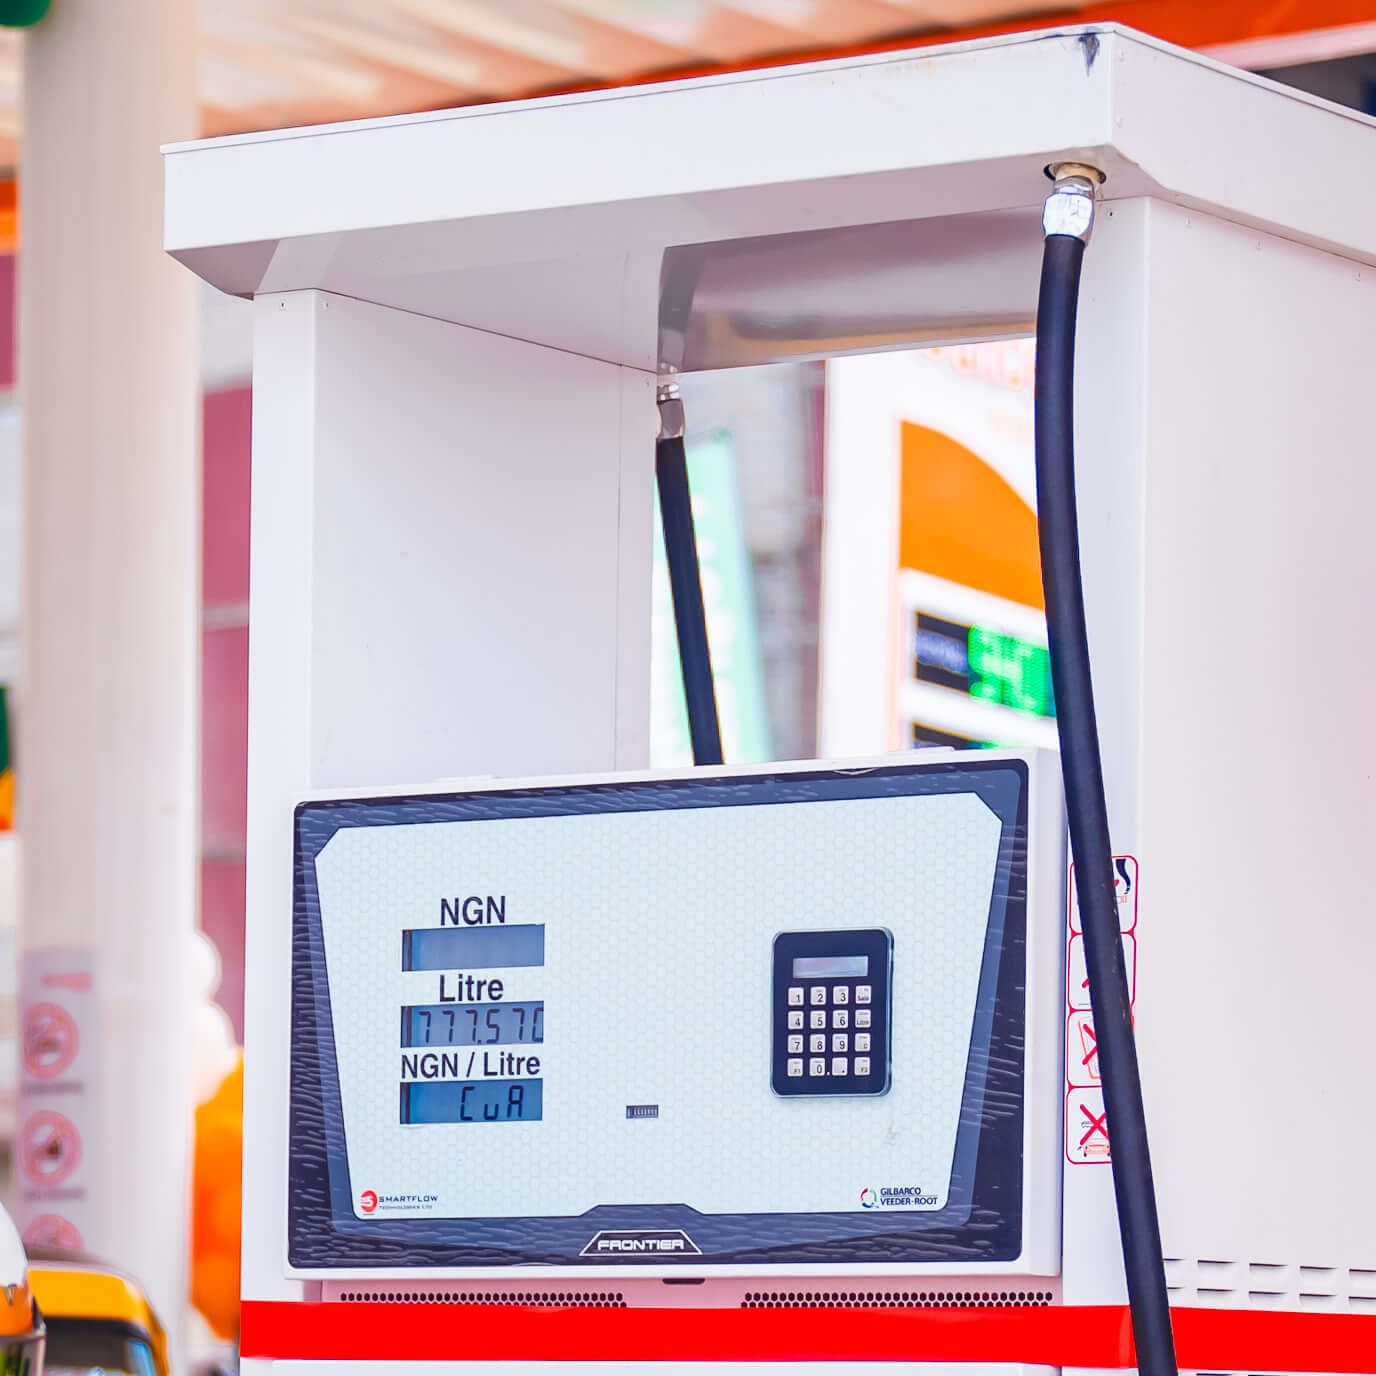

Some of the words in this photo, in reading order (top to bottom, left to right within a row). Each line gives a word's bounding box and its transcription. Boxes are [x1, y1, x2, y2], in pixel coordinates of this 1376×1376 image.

[440, 895, 506, 926] NGN
[440, 974, 504, 1002] Litre
[401, 1053, 458, 1079] NGN
[466, 1051, 476, 1078] /
[483, 1051, 541, 1077] Litre
[379, 1195, 439, 1203] SMARTFLOW
[880, 1187, 921, 1196] GILBARCO
[597, 1239, 684, 1251] FRONTIER
